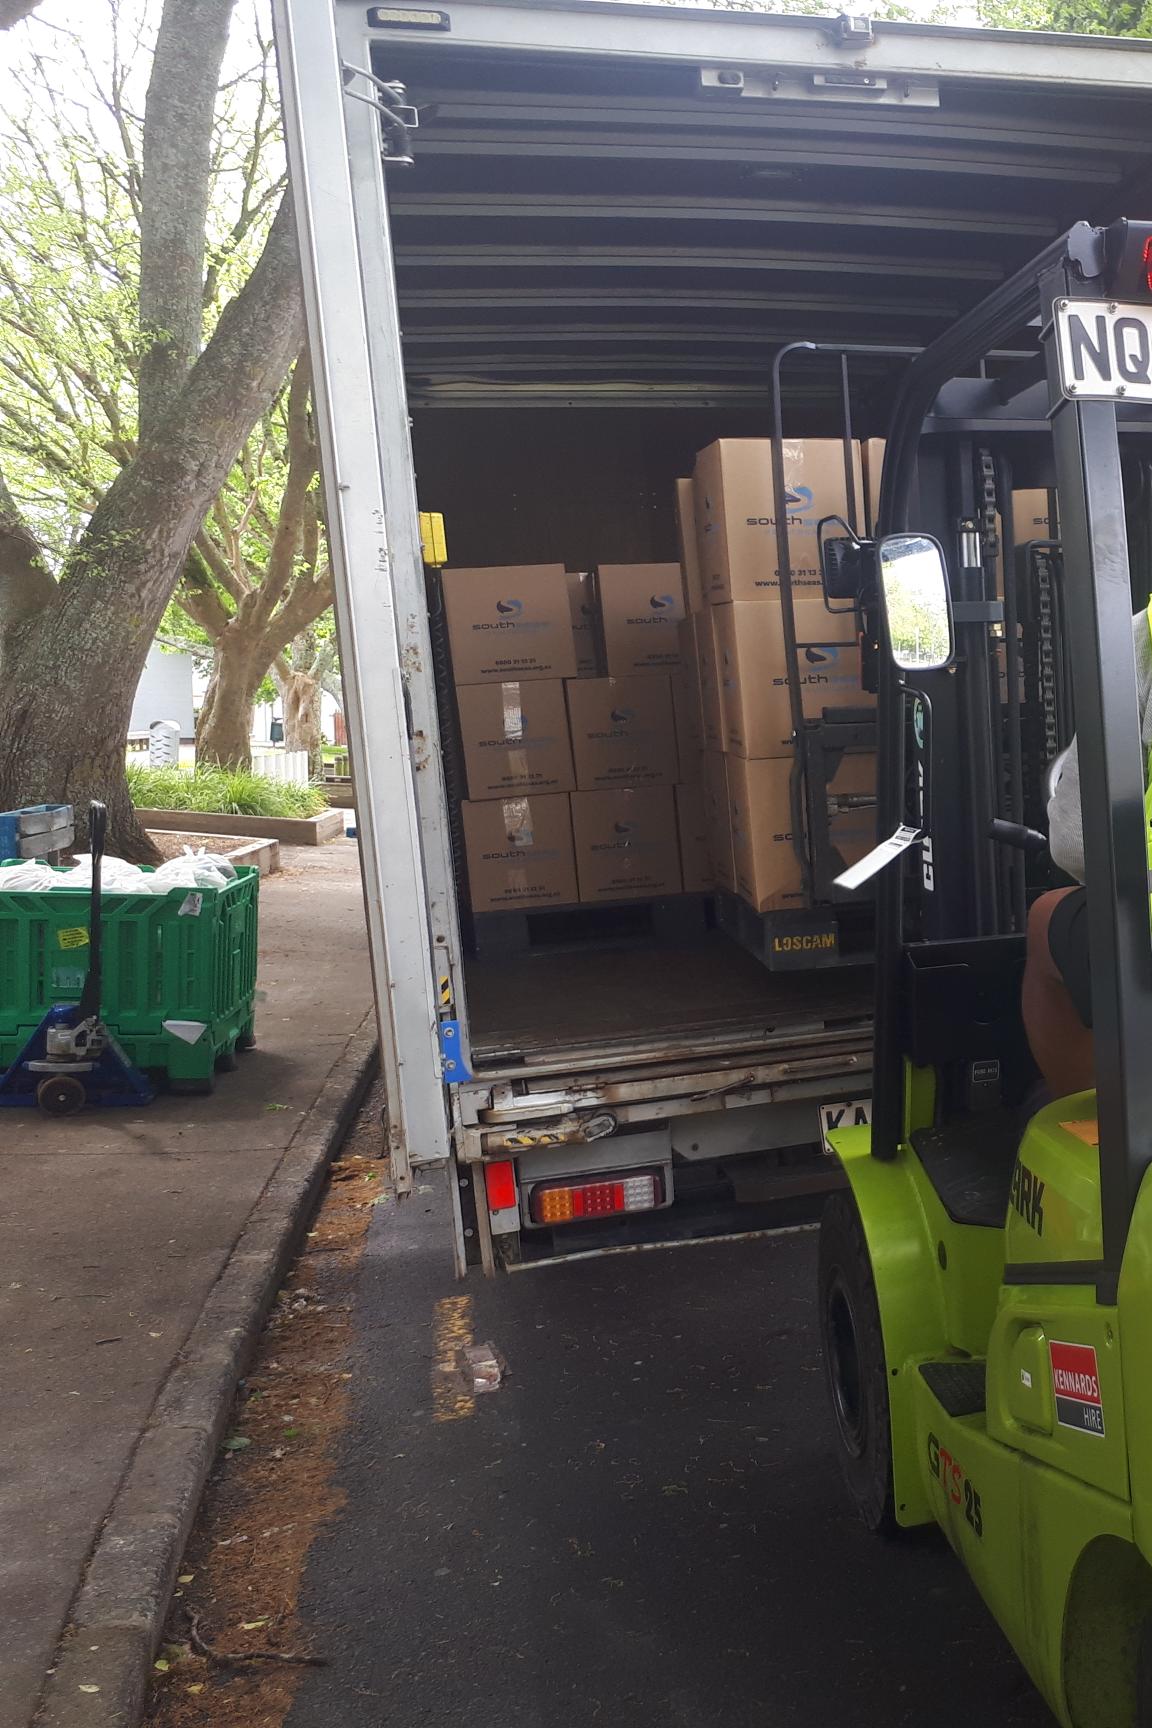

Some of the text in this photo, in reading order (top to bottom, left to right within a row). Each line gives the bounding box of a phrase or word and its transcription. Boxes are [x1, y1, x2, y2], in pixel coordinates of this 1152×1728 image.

[773, 933, 835, 952] LOSCAM
[1054, 1368, 1098, 1398] KENNARDS
[1083, 1407, 1101, 1430] HIRE
